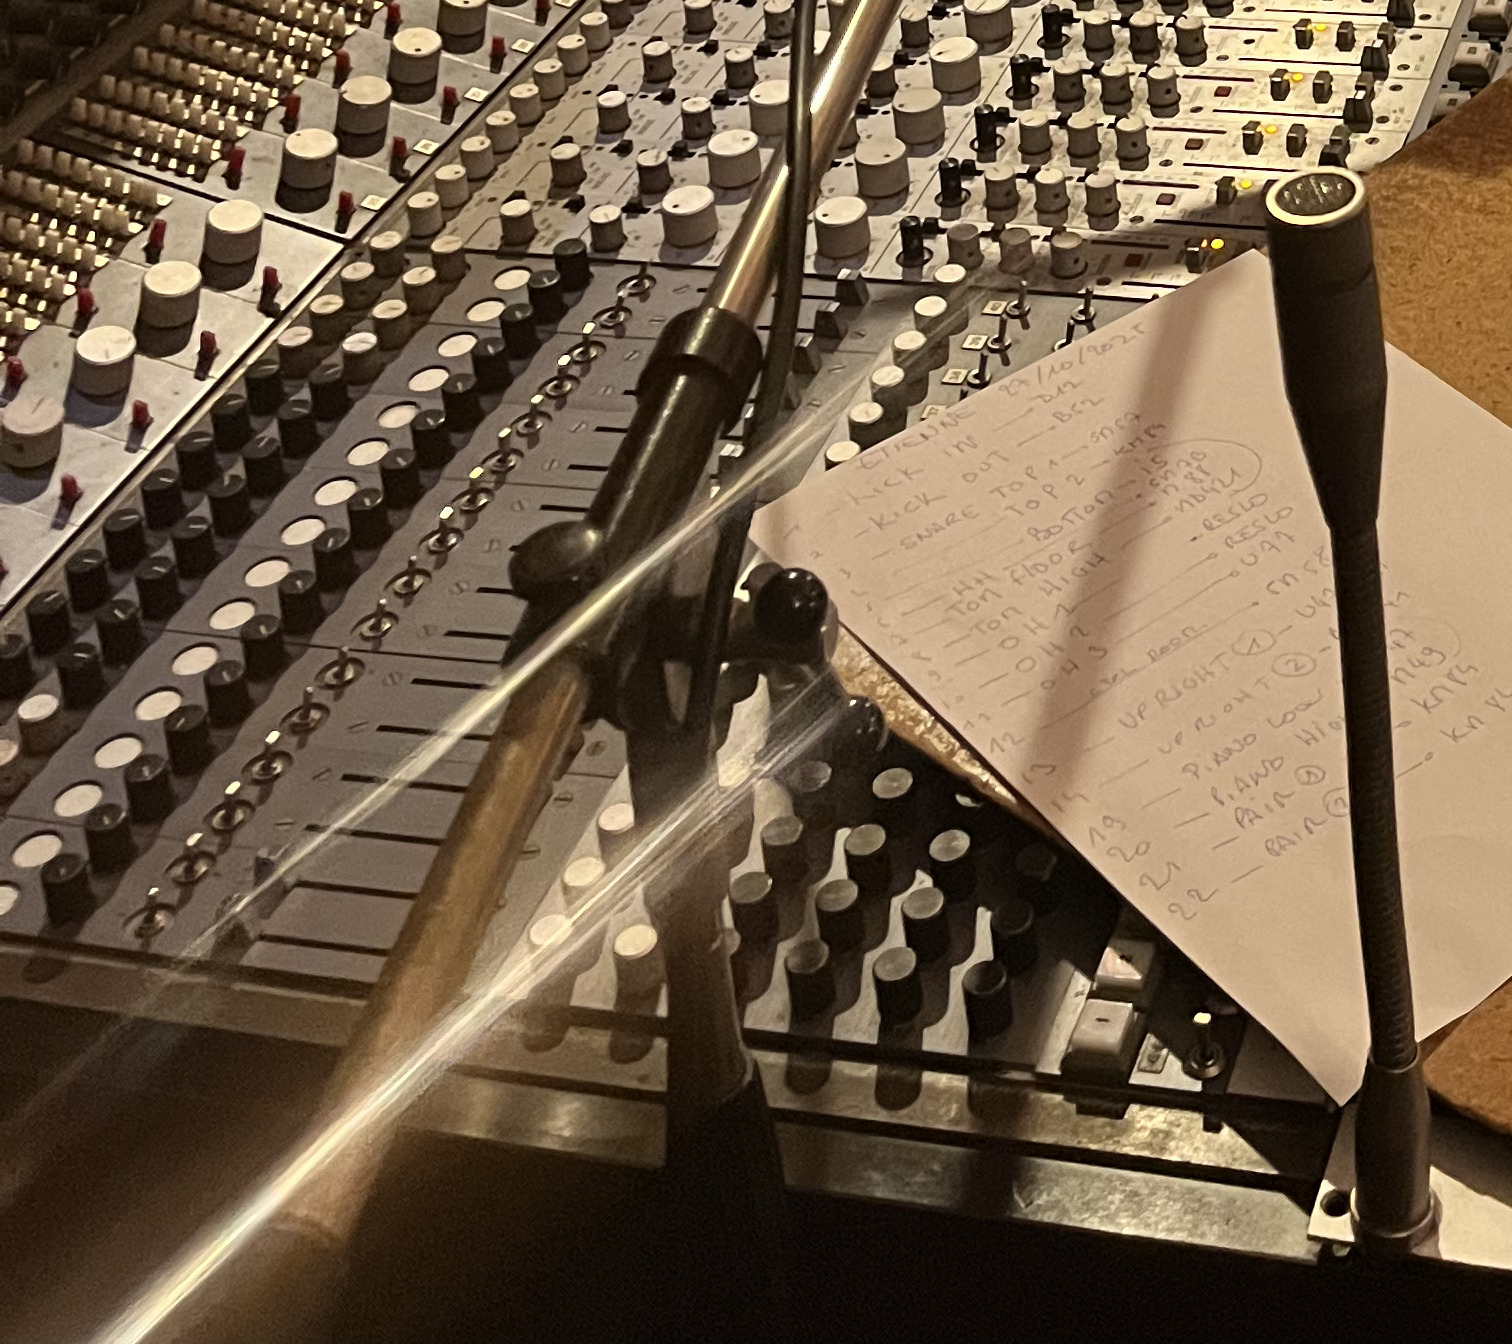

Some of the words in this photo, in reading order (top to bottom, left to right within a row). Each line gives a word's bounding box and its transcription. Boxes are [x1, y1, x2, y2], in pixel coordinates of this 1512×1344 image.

[845, 466, 924, 506] KICK
[941, 433, 978, 458] IN
[867, 489, 947, 531] KICK
[960, 449, 1011, 483] OUT
[899, 503, 980, 550] SNARE
[988, 464, 1038, 498] TOP
[1003, 482, 1058, 516] TOP
[1104, 839, 1151, 863] 20
[1138, 860, 1181, 892] 21
[1166, 887, 1220, 921] 22
